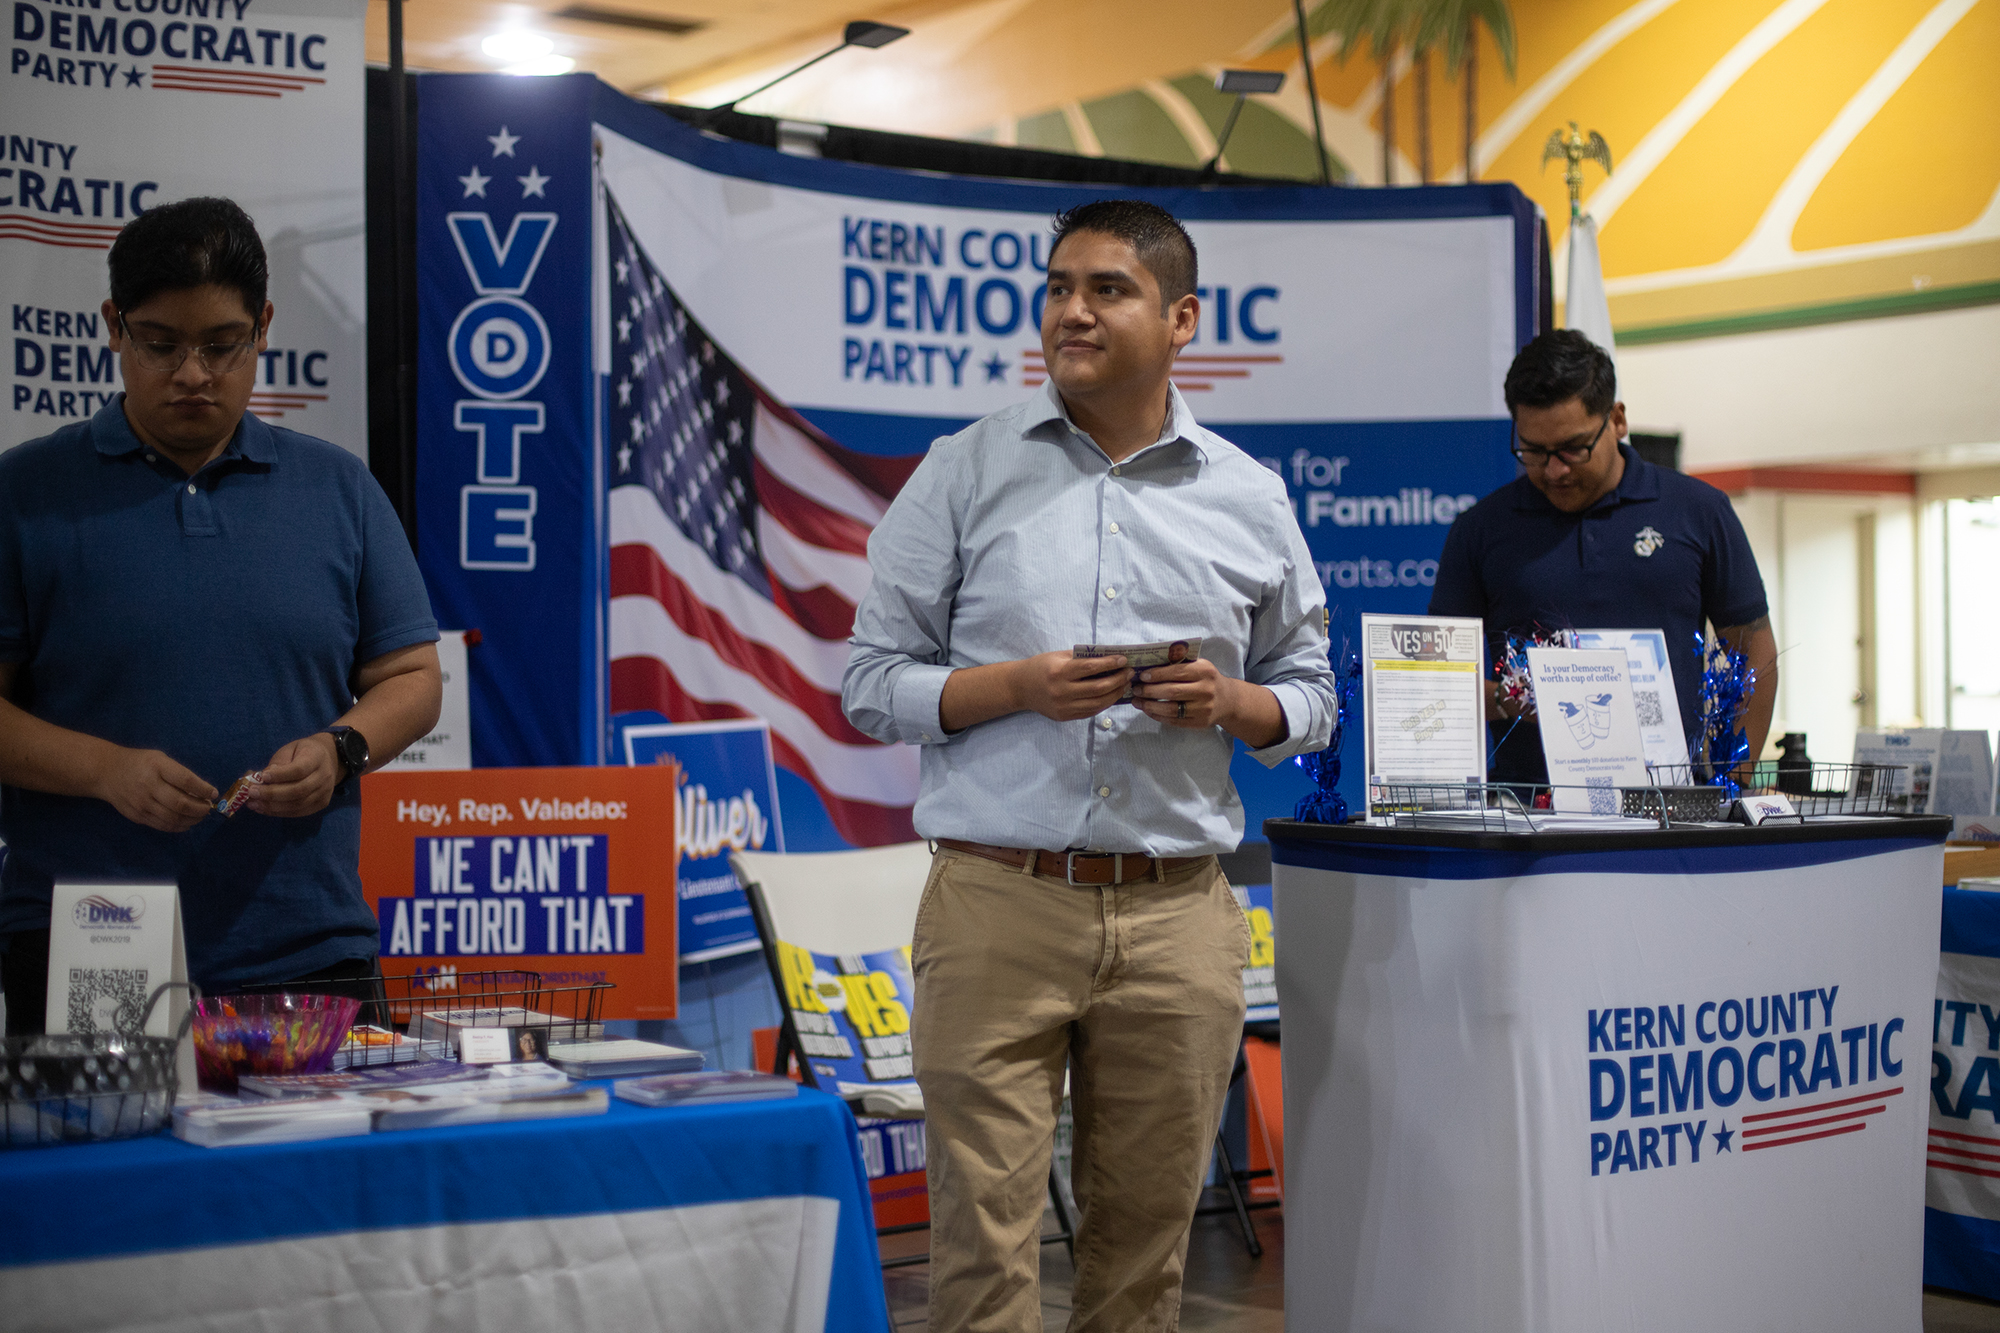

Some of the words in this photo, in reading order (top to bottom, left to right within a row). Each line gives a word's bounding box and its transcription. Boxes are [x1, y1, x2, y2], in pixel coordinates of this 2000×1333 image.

[14, 2, 328, 71] DEMOCRATIC
[11, 48, 119, 89] PARTY
[842, 216, 945, 266] KERN
[959, 230, 1054, 274] COU
[12, 304, 98, 338] KERN
[843, 337, 970, 388] PARTY
[1290, 448, 1350, 487] for
[1393, 630, 1422, 654] YES
[1422, 631, 1433, 643] ON
[1434, 630, 1451, 654] 50
[1540, 674, 1564, 683] worth
[1571, 675, 1586, 684] cup
[1586, 673, 1595, 682] of
[1595, 672, 1622, 682] coffee?
[1543, 664, 1551, 673] Is
[1552, 665, 1570, 675] your
[1571, 663, 1615, 675] Democracy
[1418, 704, 1436, 721] YES
[397, 799, 452, 826] Hey,
[459, 799, 513, 826] Rep.
[520, 798, 627, 821] Valadao:
[429, 838, 474, 895] WE
[490, 836, 595, 893] CAN'T
[89, 905, 134, 923] DWK
[389, 899, 526, 956] AFFORD
[540, 897, 633, 954] THAT
[1588, 1004, 1686, 1053] KERN
[1695, 985, 1840, 1044] COUNTY
[1588, 1017, 1905, 1123] DEMOCRATIC
[1590, 1119, 1708, 1177] PARTY
